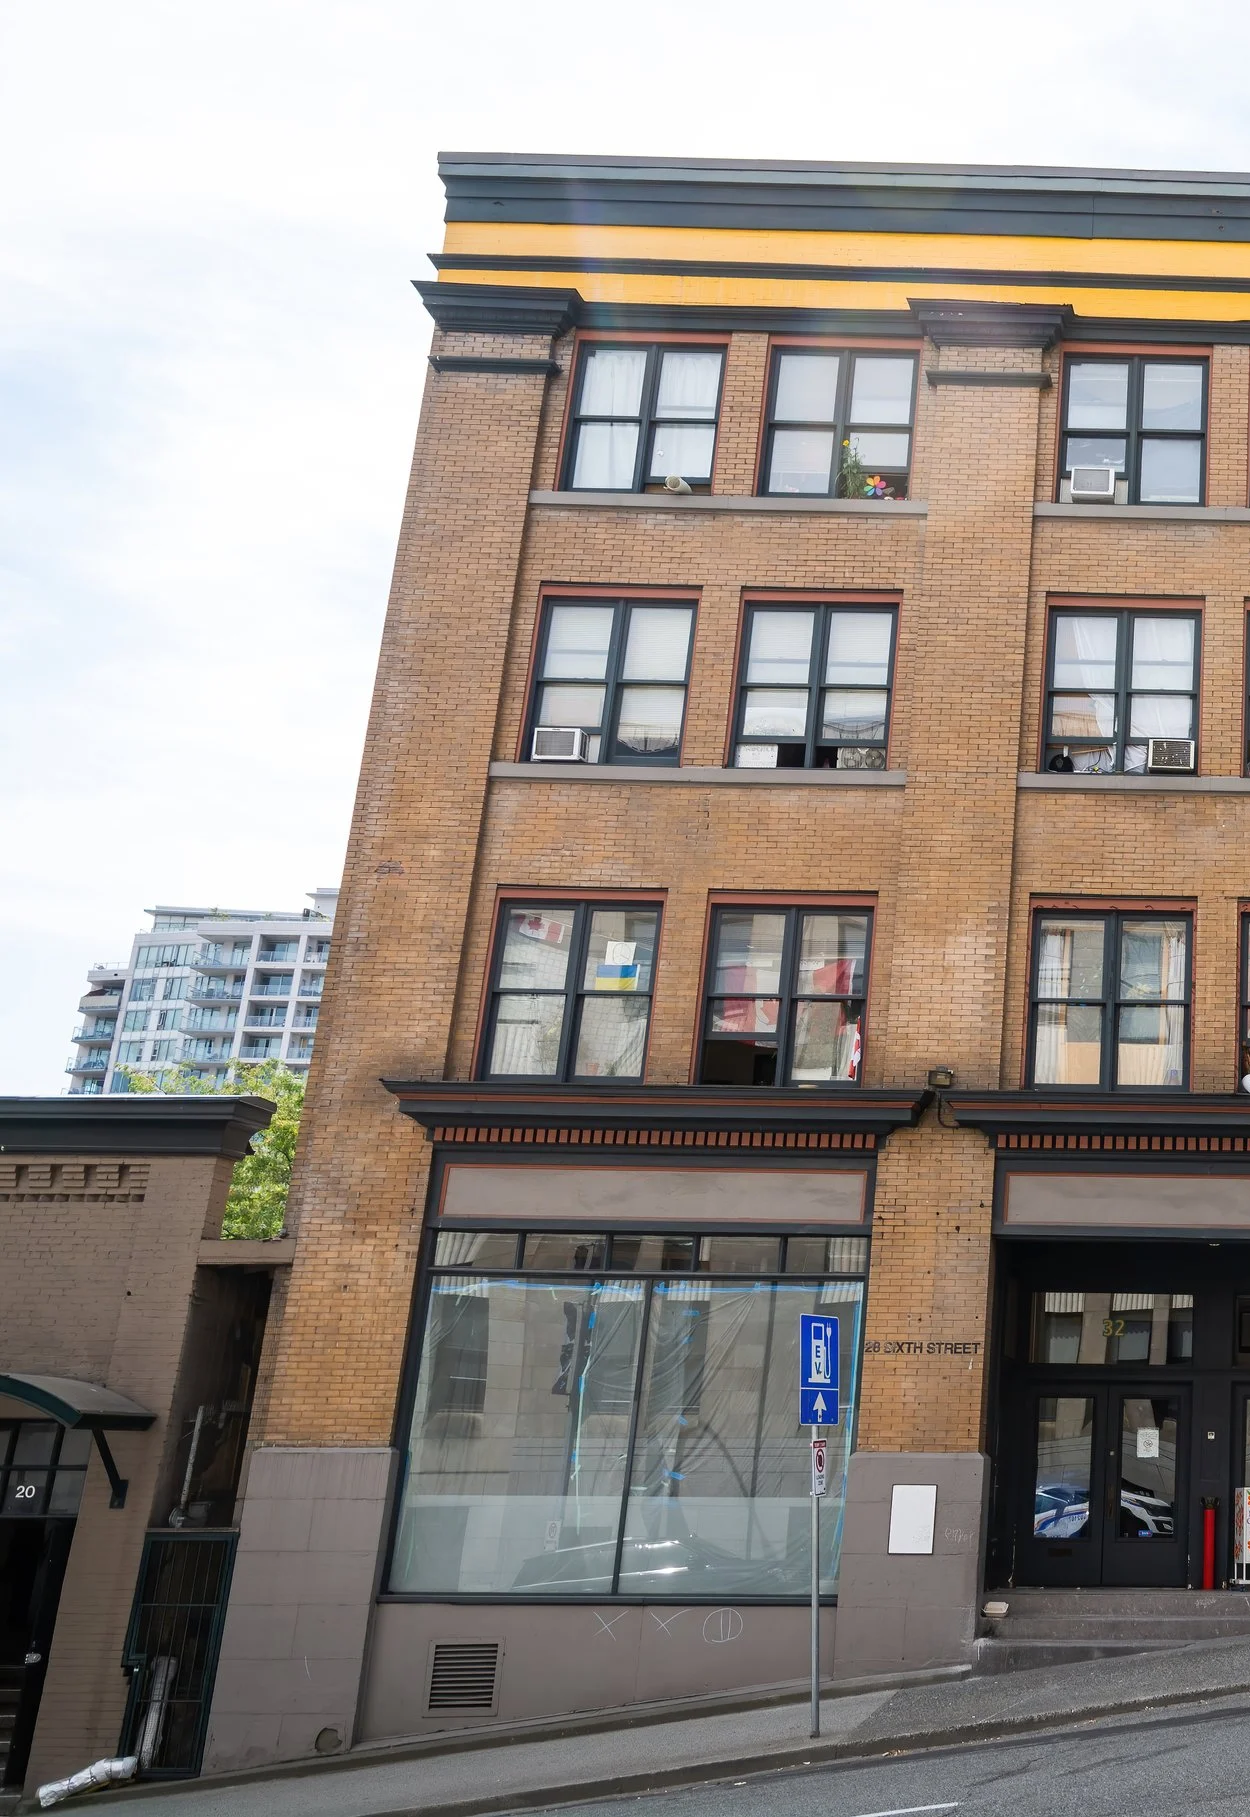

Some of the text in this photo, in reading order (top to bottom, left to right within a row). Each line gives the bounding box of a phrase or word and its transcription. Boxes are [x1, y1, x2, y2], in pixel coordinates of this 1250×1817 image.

[1103, 1319, 1125, 1337] 32
[865, 1342, 981, 1355] 28 SIXTH STREET
[15, 1485, 36, 1498] 20
